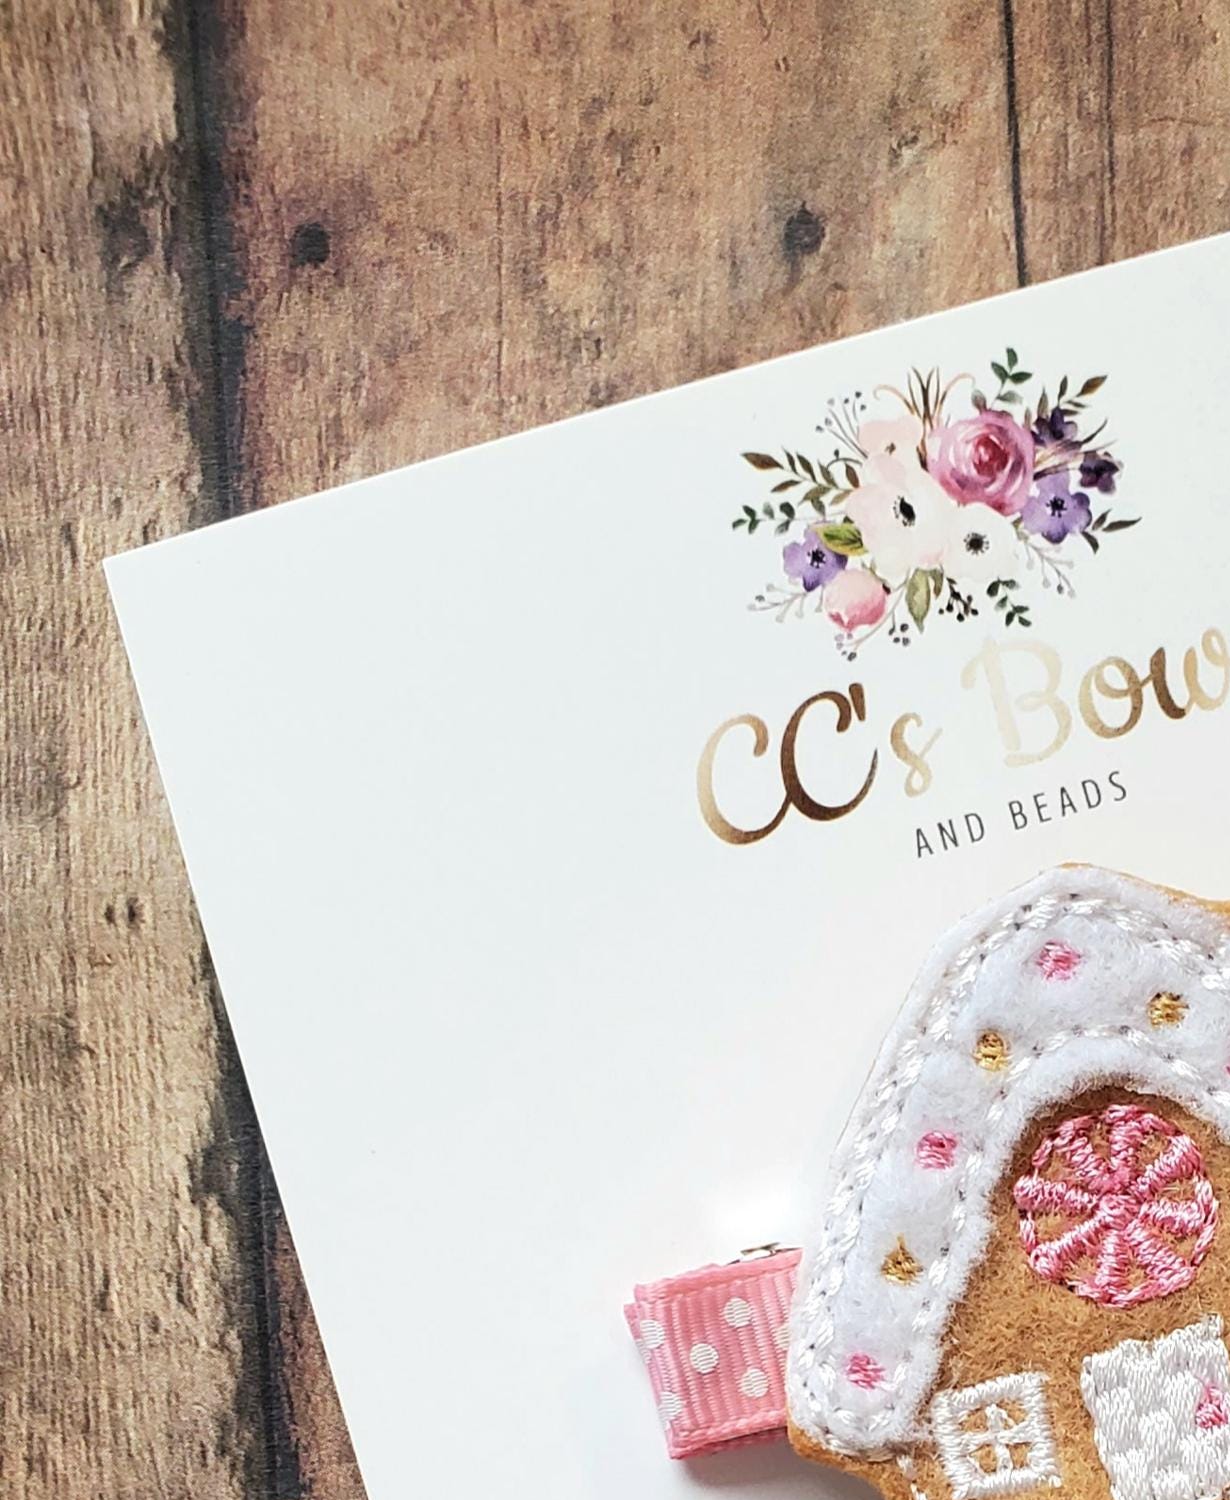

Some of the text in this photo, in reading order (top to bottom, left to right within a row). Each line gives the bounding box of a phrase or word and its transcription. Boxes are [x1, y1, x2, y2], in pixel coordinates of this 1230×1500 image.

[696, 682, 942, 846] CC's
[914, 771, 1129, 859] AND BEADS
